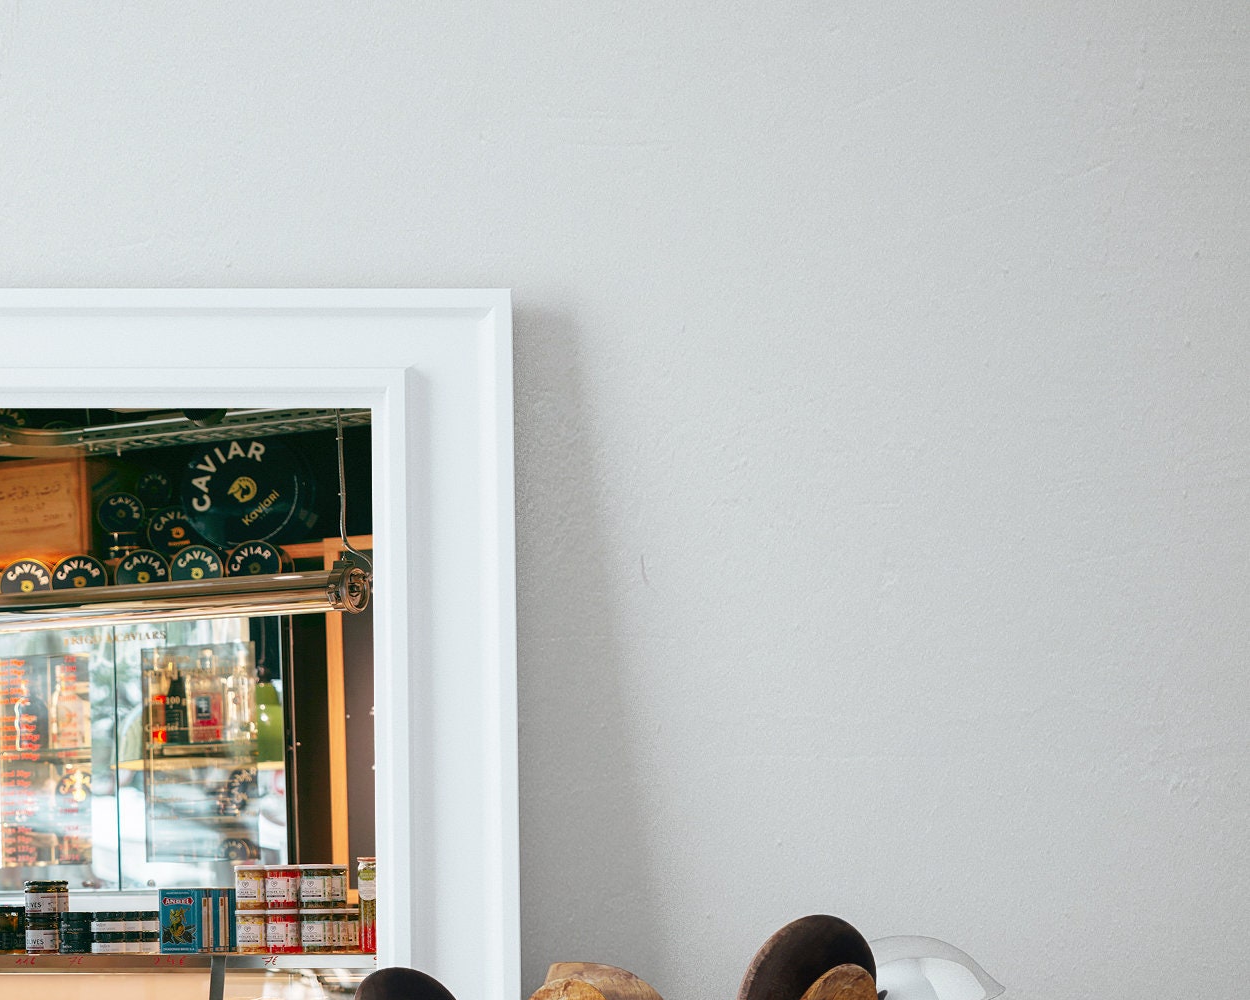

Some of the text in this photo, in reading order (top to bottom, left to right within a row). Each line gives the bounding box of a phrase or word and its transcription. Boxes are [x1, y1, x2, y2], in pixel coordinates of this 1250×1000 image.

[191, 441, 266, 512] CAVIAR
[109, 497, 141, 519] CAVIAR
[153, 511, 189, 531] CAVIA
[56, 560, 101, 580] CAVIAR
[124, 555, 166, 577] CAVIAR
[177, 550, 219, 573] CAVIAR
[231, 546, 272, 572] CAVIAR
[7, 563, 49, 585] CAVIAR
